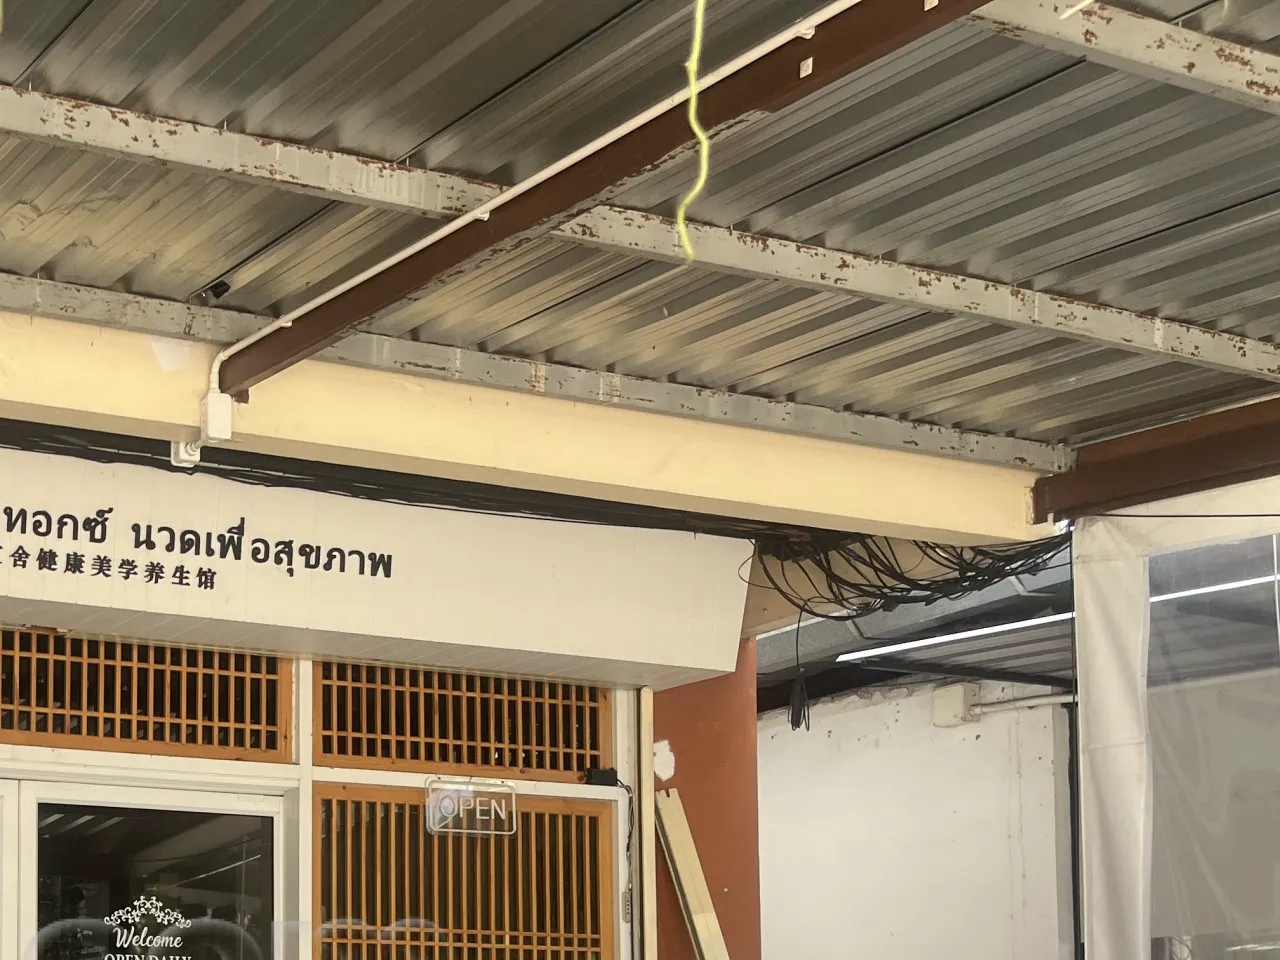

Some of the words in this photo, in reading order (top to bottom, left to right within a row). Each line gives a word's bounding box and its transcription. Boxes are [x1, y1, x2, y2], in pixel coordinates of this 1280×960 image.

[131, 516, 393, 579] นวดเพื่อสุขภาพ
[438, 795, 507, 822] OPEN
[112, 926, 184, 948] Welcome
